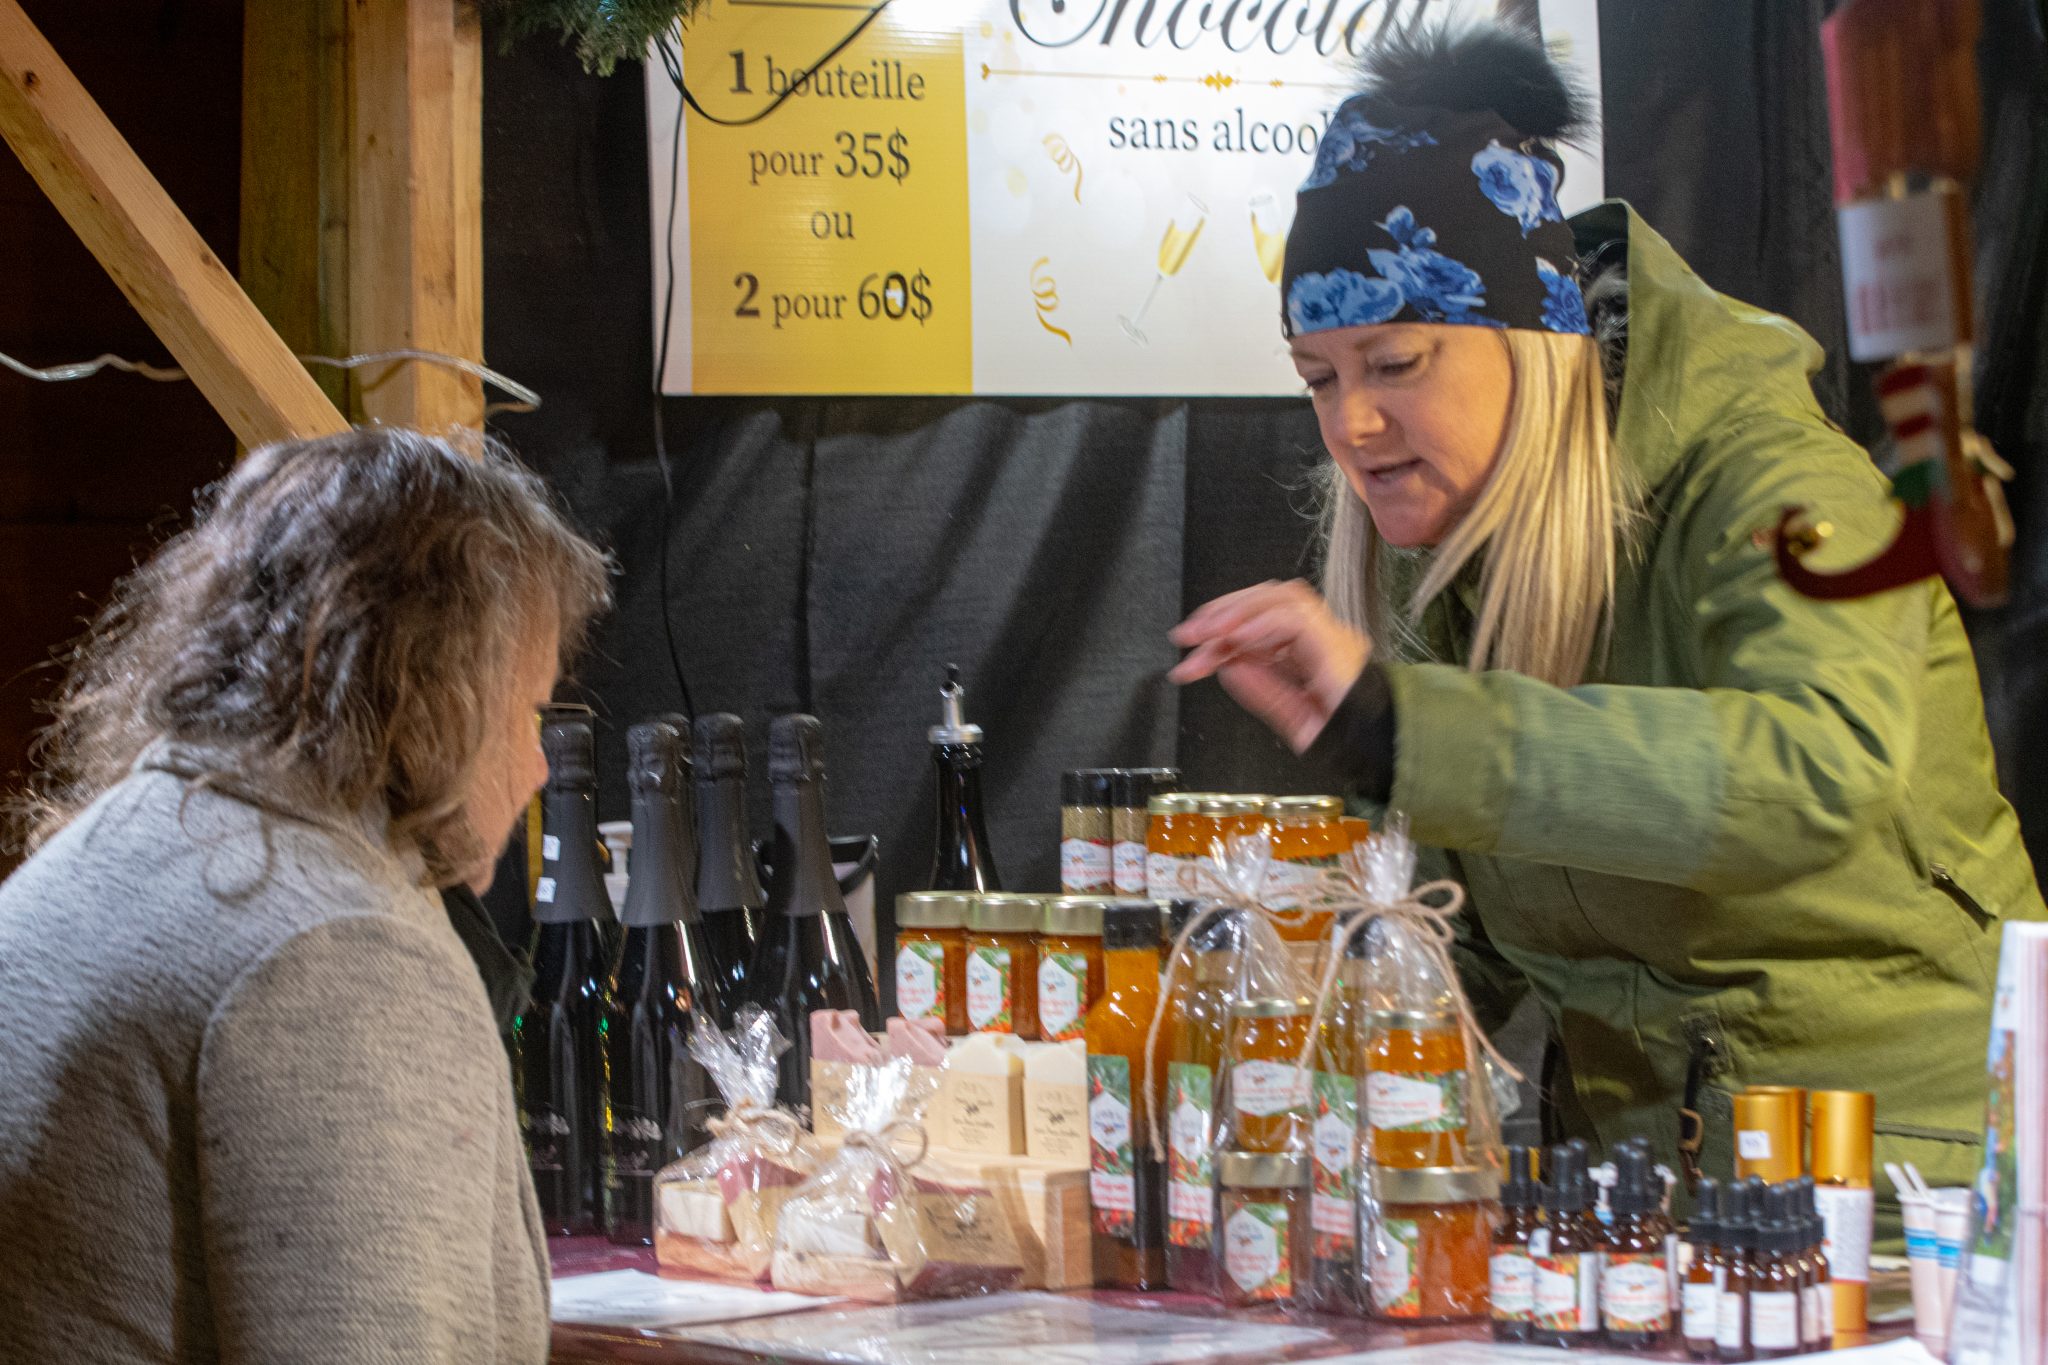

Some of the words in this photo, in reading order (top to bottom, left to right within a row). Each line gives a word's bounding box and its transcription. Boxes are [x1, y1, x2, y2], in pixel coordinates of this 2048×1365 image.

[728, 49, 753, 95] 1
[764, 54, 926, 101] bouteille
[749, 148, 824, 186] pour
[834, 127, 911, 186] 35$
[1109, 115, 1200, 152] sans
[810, 208, 856, 241] ou
[733, 271, 761, 319] 2
[771, 292, 848, 330] pour
[857, 267, 933, 327] 60$
